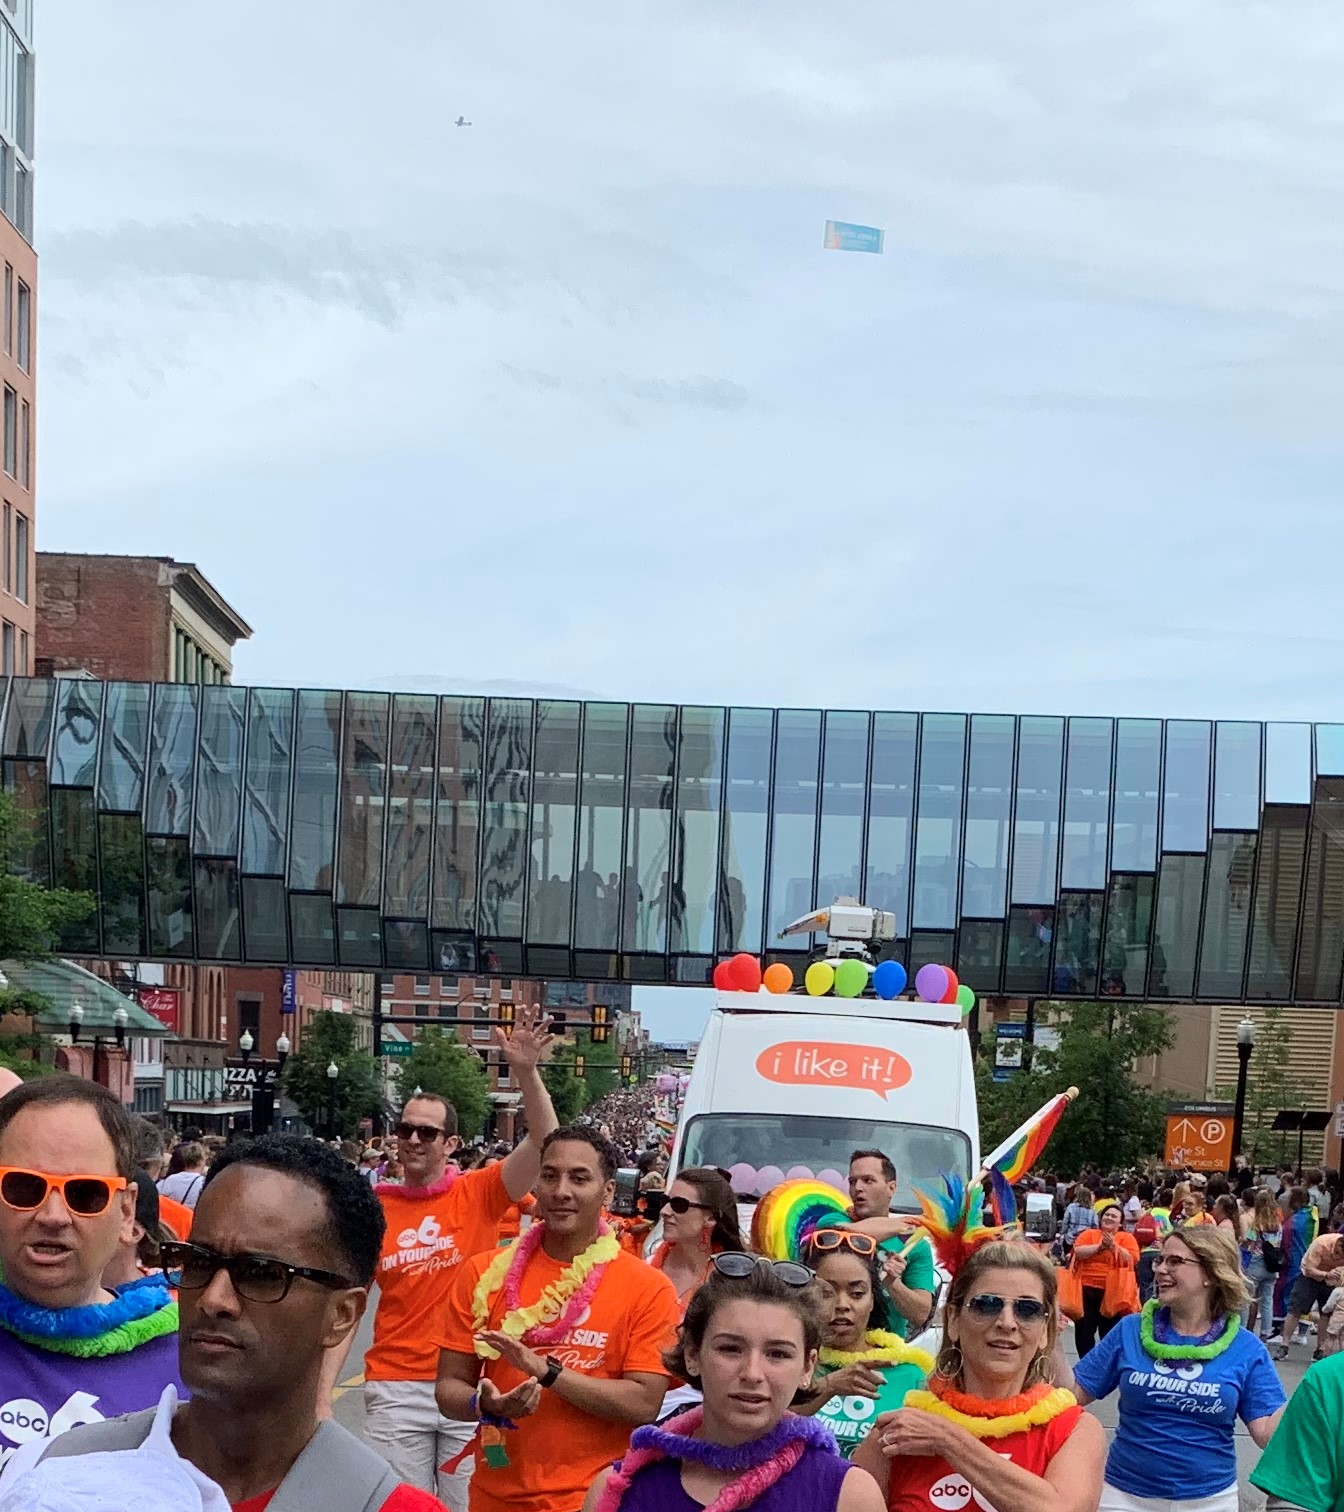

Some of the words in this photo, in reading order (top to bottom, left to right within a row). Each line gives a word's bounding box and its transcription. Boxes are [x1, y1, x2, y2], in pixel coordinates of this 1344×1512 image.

[384, 1043, 403, 1053] Vine
[773, 1051, 783, 1076] i
[794, 1048, 848, 1079] like
[861, 1056, 896, 1083] it!
[418, 1215, 442, 1246] 6
[382, 1253, 398, 1272] ON
[433, 1234, 455, 1251] IDE
[571, 1328, 609, 1350] SIDE
[1128, 1371, 1149, 1387] ON
[1148, 1373, 1189, 1393] YOUR
[1188, 1381, 1221, 1398] SIDE
[1176, 1398, 1227, 1415] Pride
